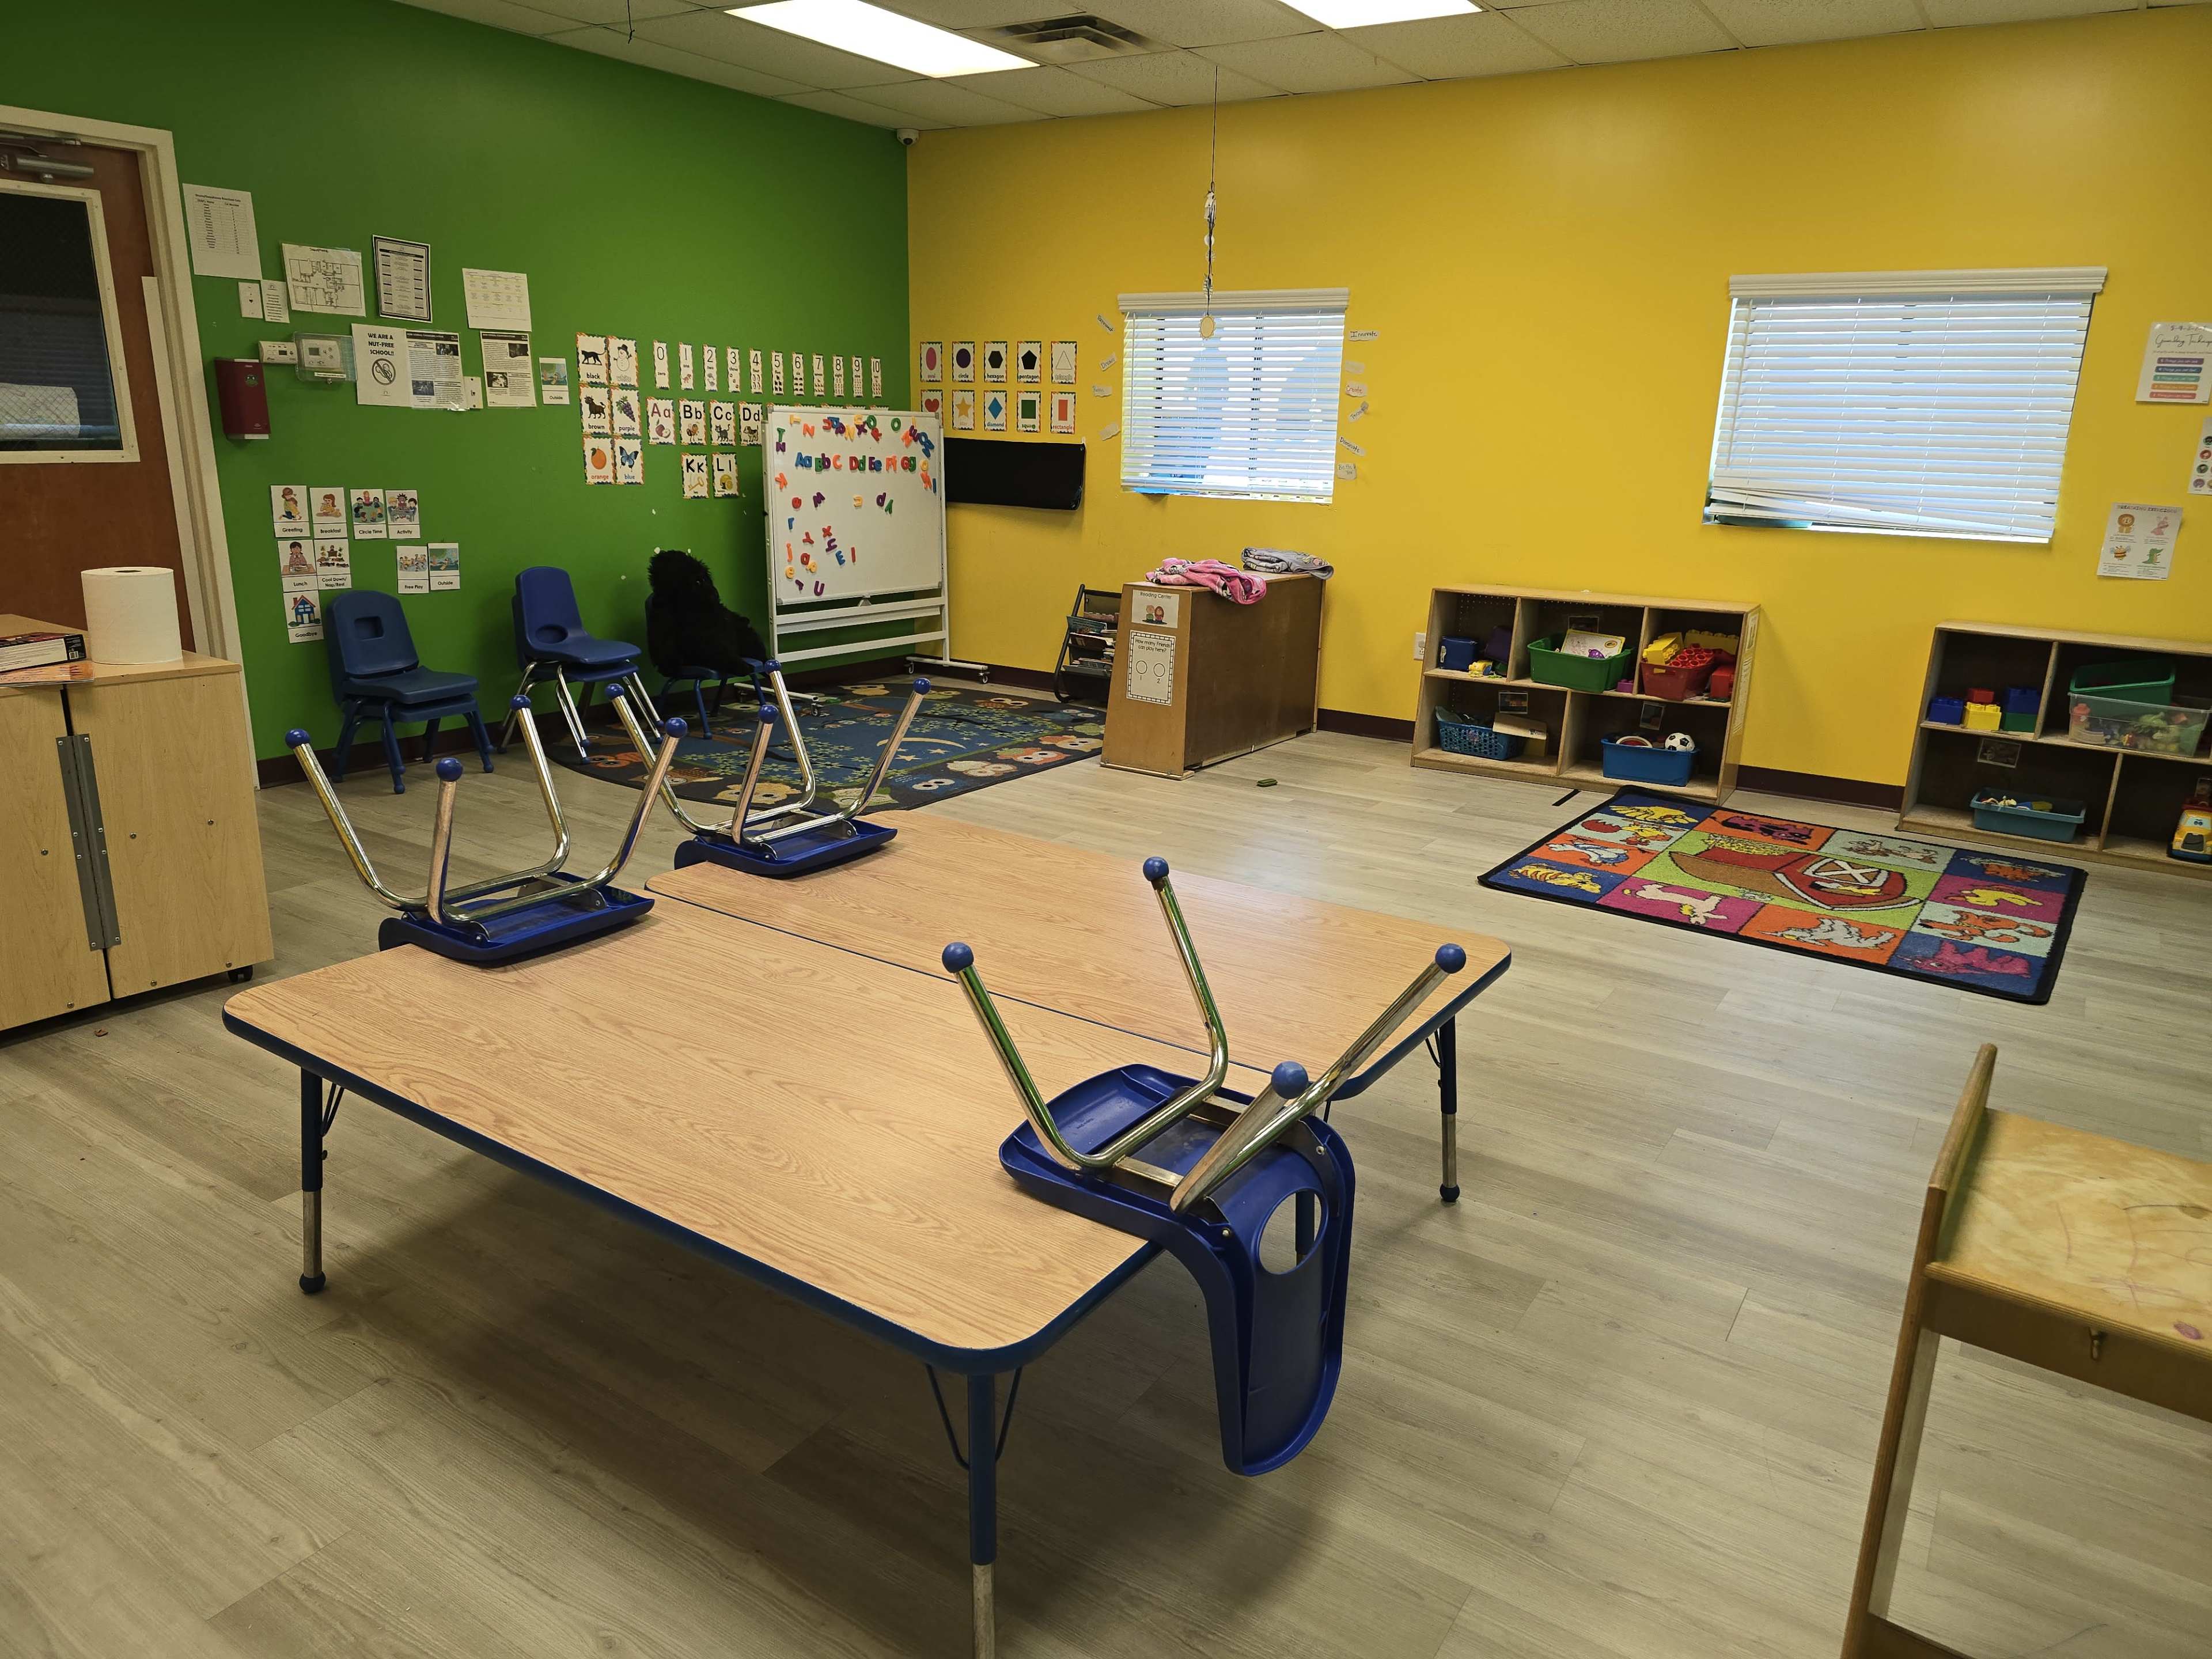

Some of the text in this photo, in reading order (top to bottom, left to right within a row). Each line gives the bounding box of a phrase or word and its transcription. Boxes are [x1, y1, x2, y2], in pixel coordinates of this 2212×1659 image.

[656, 346, 665, 361] 0
[684, 349, 688, 361] 1
[707, 349, 714, 363] 2
[730, 351, 737, 365] 3
[752, 353, 759, 366] 4
[774, 355, 781, 368] 5
[795, 357, 801, 369] 6
[815, 358, 821, 370] 7
[835, 358, 841, 371] 8
[854, 359, 861, 372] 9
[872, 361, 880, 373] 10
[651, 403, 671, 418] Aa
[683, 404, 702, 420] Bb
[713, 406, 732, 421] Cc
[742, 407, 760, 422] Dd
[803, 423, 815, 437] N
[891, 417, 901, 431] O
